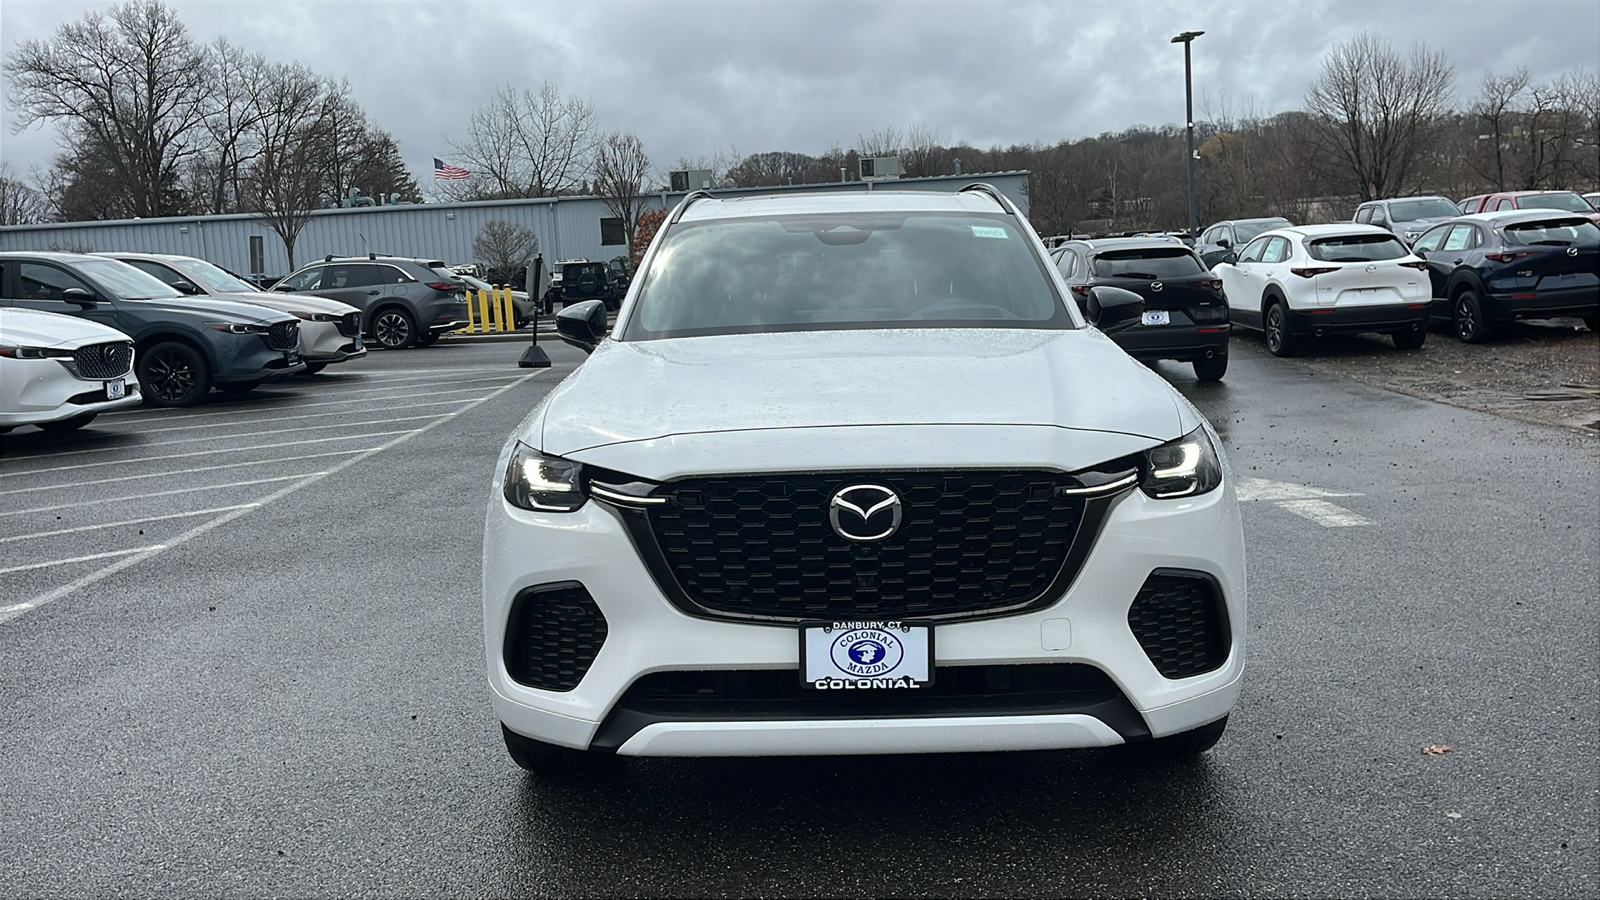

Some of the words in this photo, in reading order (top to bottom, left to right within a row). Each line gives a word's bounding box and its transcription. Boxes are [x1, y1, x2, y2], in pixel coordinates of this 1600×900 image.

[833, 621, 885, 630] DANBURY,
[887, 621, 902, 629] CT
[840, 631, 894, 648] COLONIAL
[847, 662, 889, 674] MAZDA
[815, 679, 920, 689] COLONIAL
